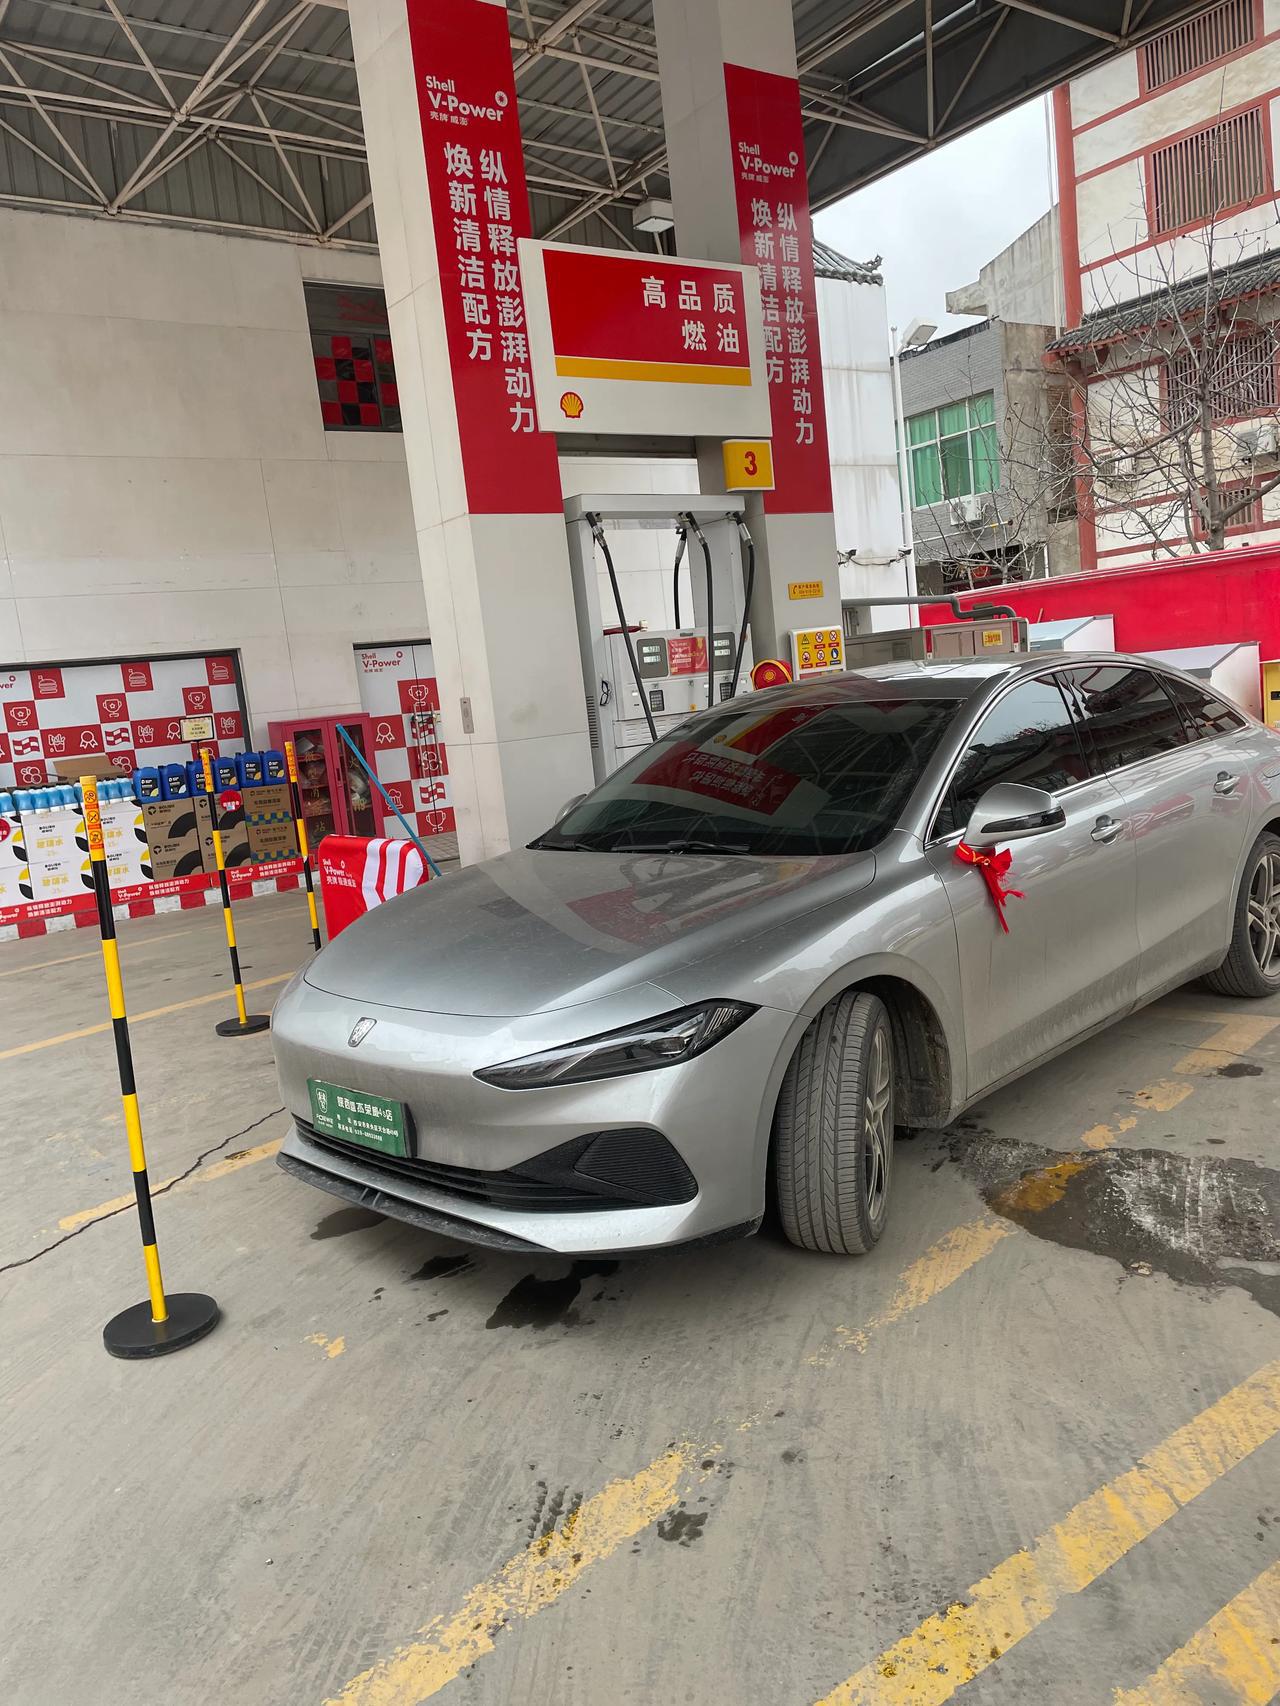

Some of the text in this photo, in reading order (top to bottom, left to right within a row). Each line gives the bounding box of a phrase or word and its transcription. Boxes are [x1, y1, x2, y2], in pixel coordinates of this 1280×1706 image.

[425, 75, 455, 93] Shell
[427, 90, 504, 122] V-Power
[738, 141, 760, 156] Shell
[740, 154, 796, 178] V-Power
[443, 141, 492, 361] 焕新清洁配方
[479, 148, 535, 433] 纵情释放澎湃动力
[641, 275, 736, 314] 高品质
[751, 198, 785, 384] 焕新清洁配方
[681, 319, 740, 354] 燃油
[776, 202, 815, 445] 纵情释放澎湃动力
[743, 450, 758, 477] 3
[362, 659, 401, 668] V-Power
